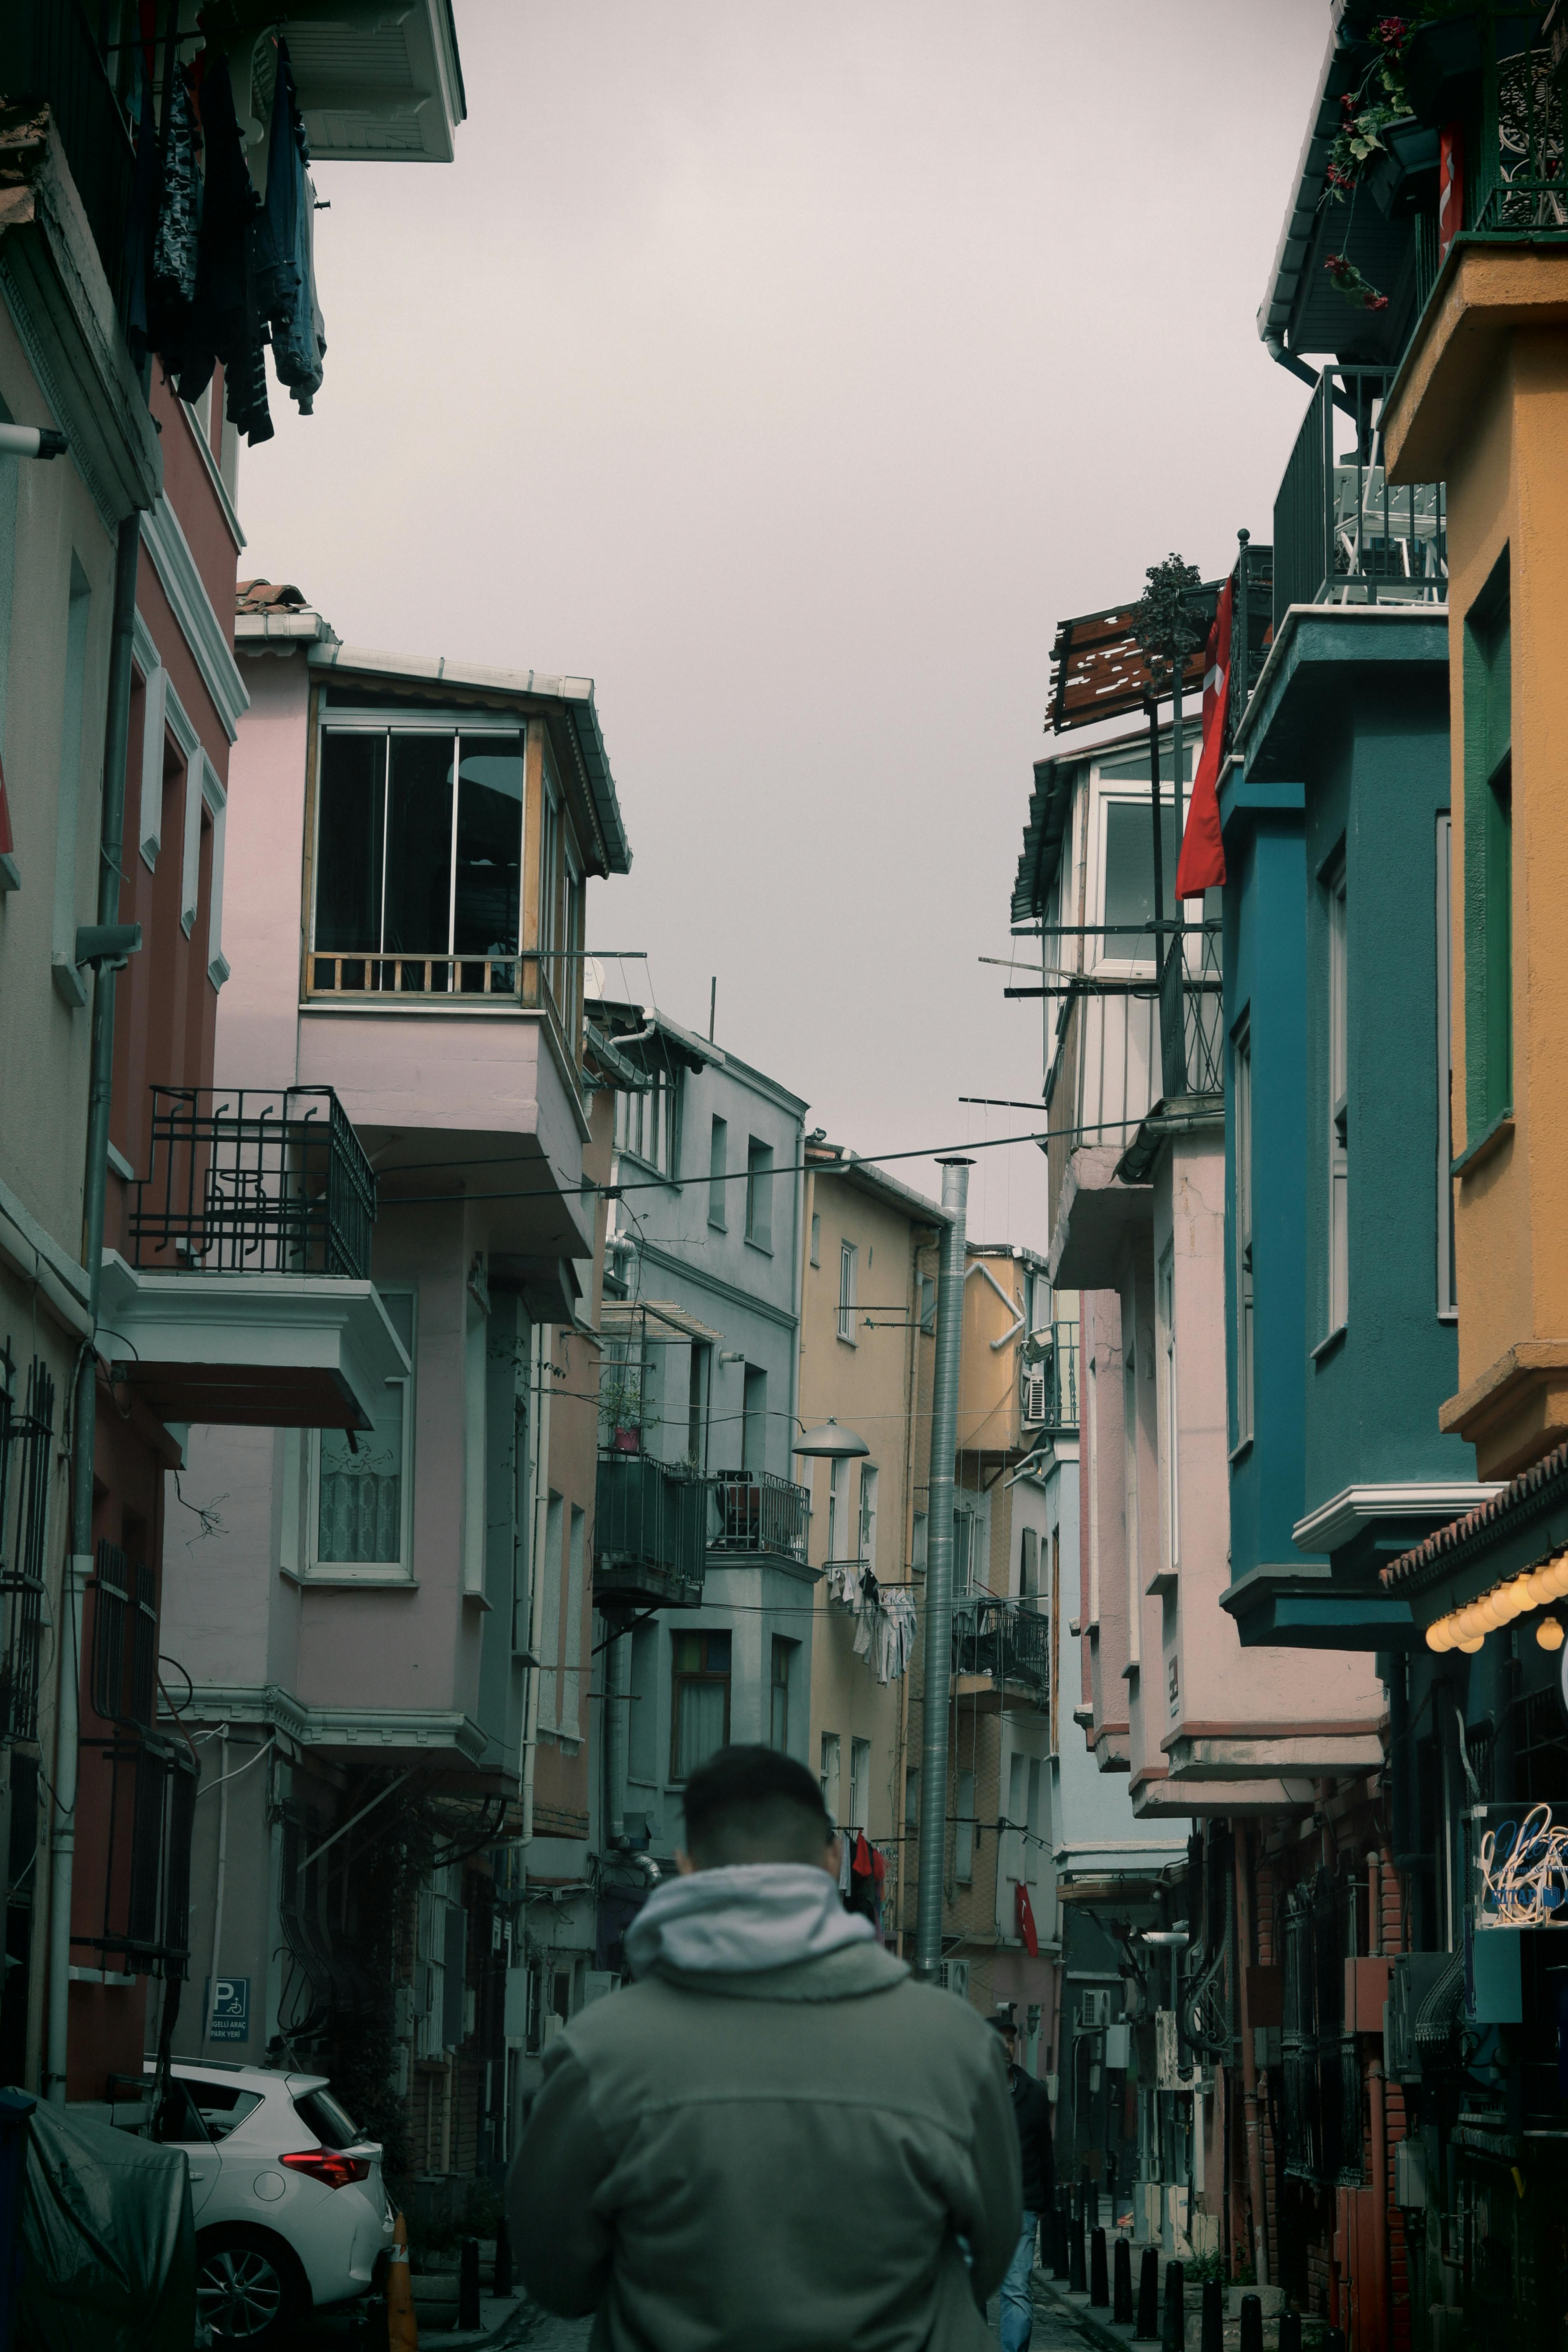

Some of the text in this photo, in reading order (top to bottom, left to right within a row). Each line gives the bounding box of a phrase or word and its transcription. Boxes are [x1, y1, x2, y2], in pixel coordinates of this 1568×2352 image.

[1490, 1865, 1531, 1873] Akademi
[214, 1983, 234, 2010] P
[230, 2021, 246, 2030] ARAÇ
